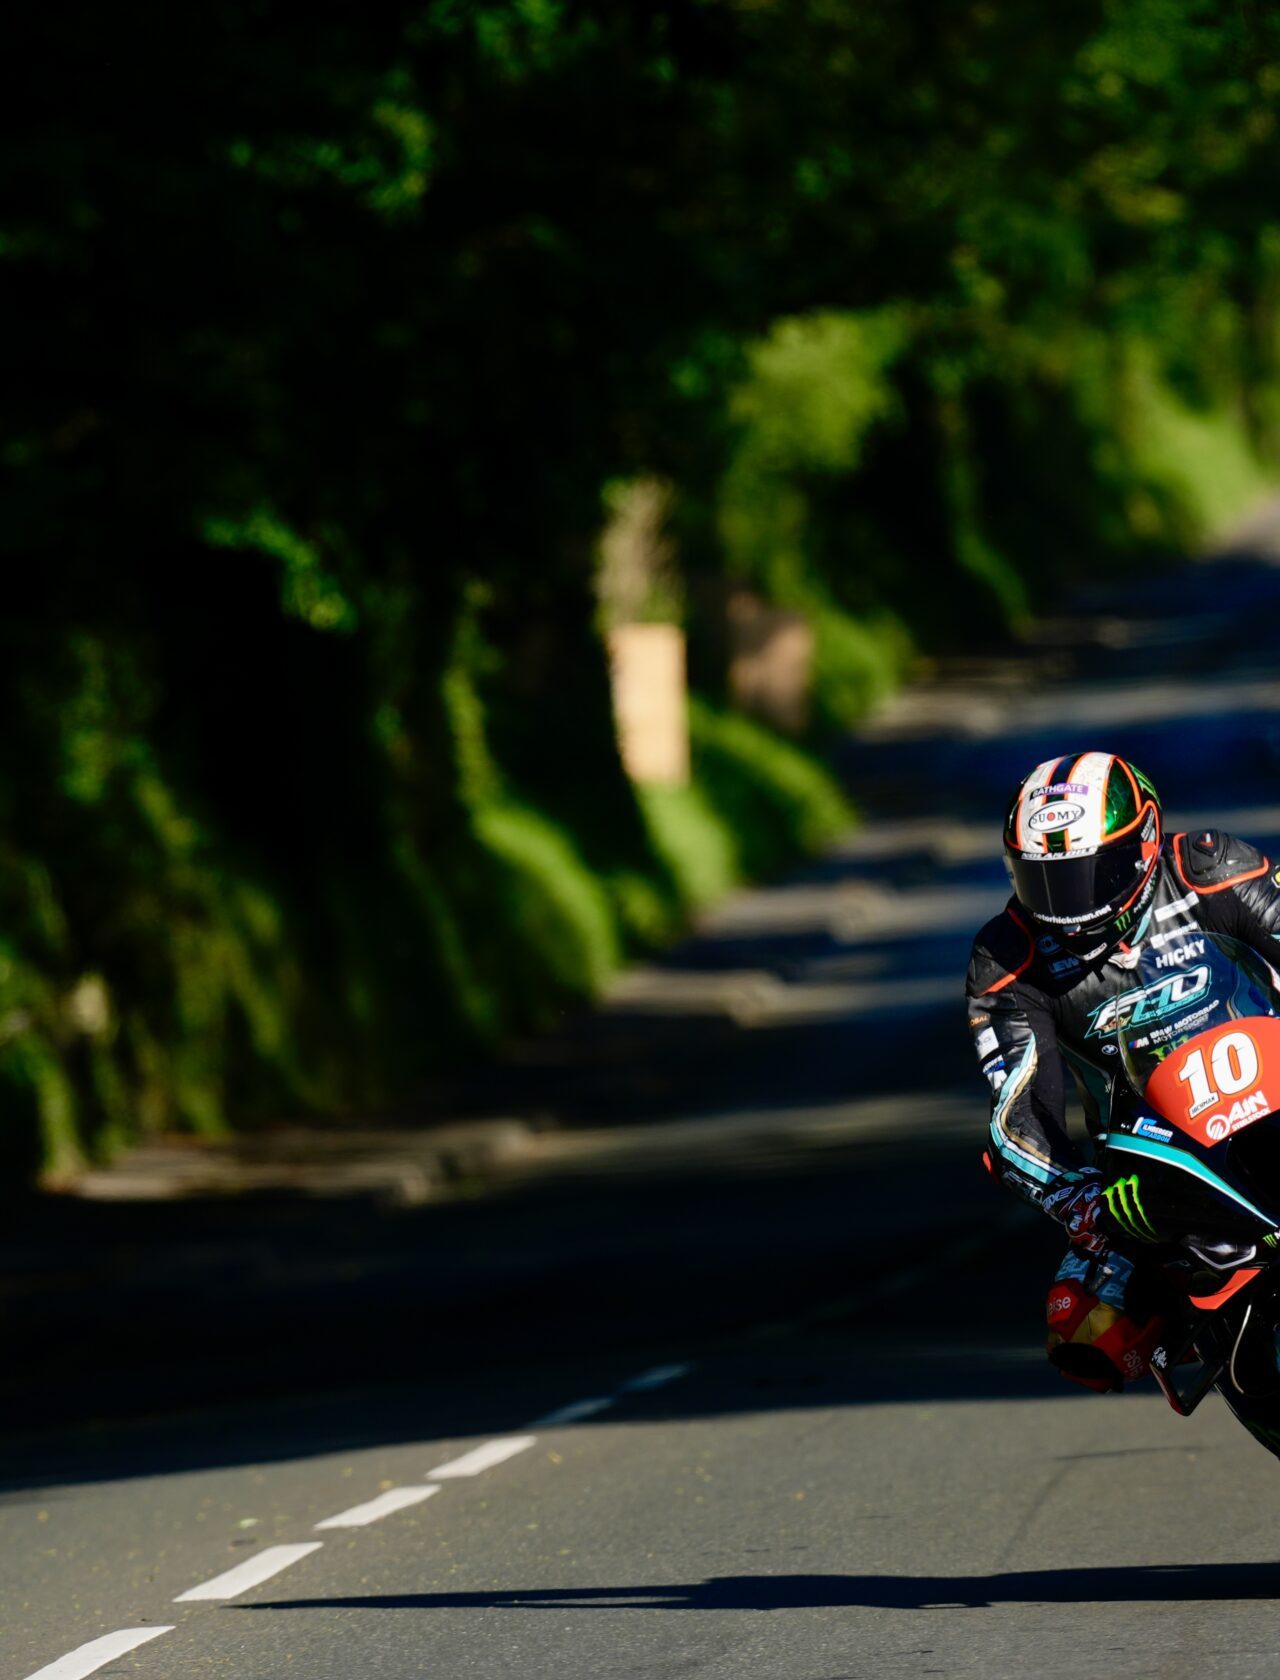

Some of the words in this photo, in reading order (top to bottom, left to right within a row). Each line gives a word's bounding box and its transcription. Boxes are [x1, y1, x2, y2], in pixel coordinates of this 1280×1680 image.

[1032, 783, 1083, 798] BATHGATE
[1031, 810, 1080, 825] SUOMY
[1155, 939, 1205, 969] HICKY
[1149, 1027, 1173, 1039] BMW
[1174, 999, 1220, 1030] MOTORRAD
[1153, 1013, 1210, 1045] MOTORSPORT
[1178, 1031, 1259, 1120] 10
[1228, 1090, 1269, 1125] AJN
[1231, 1107, 1272, 1132] STEELSTOCK
